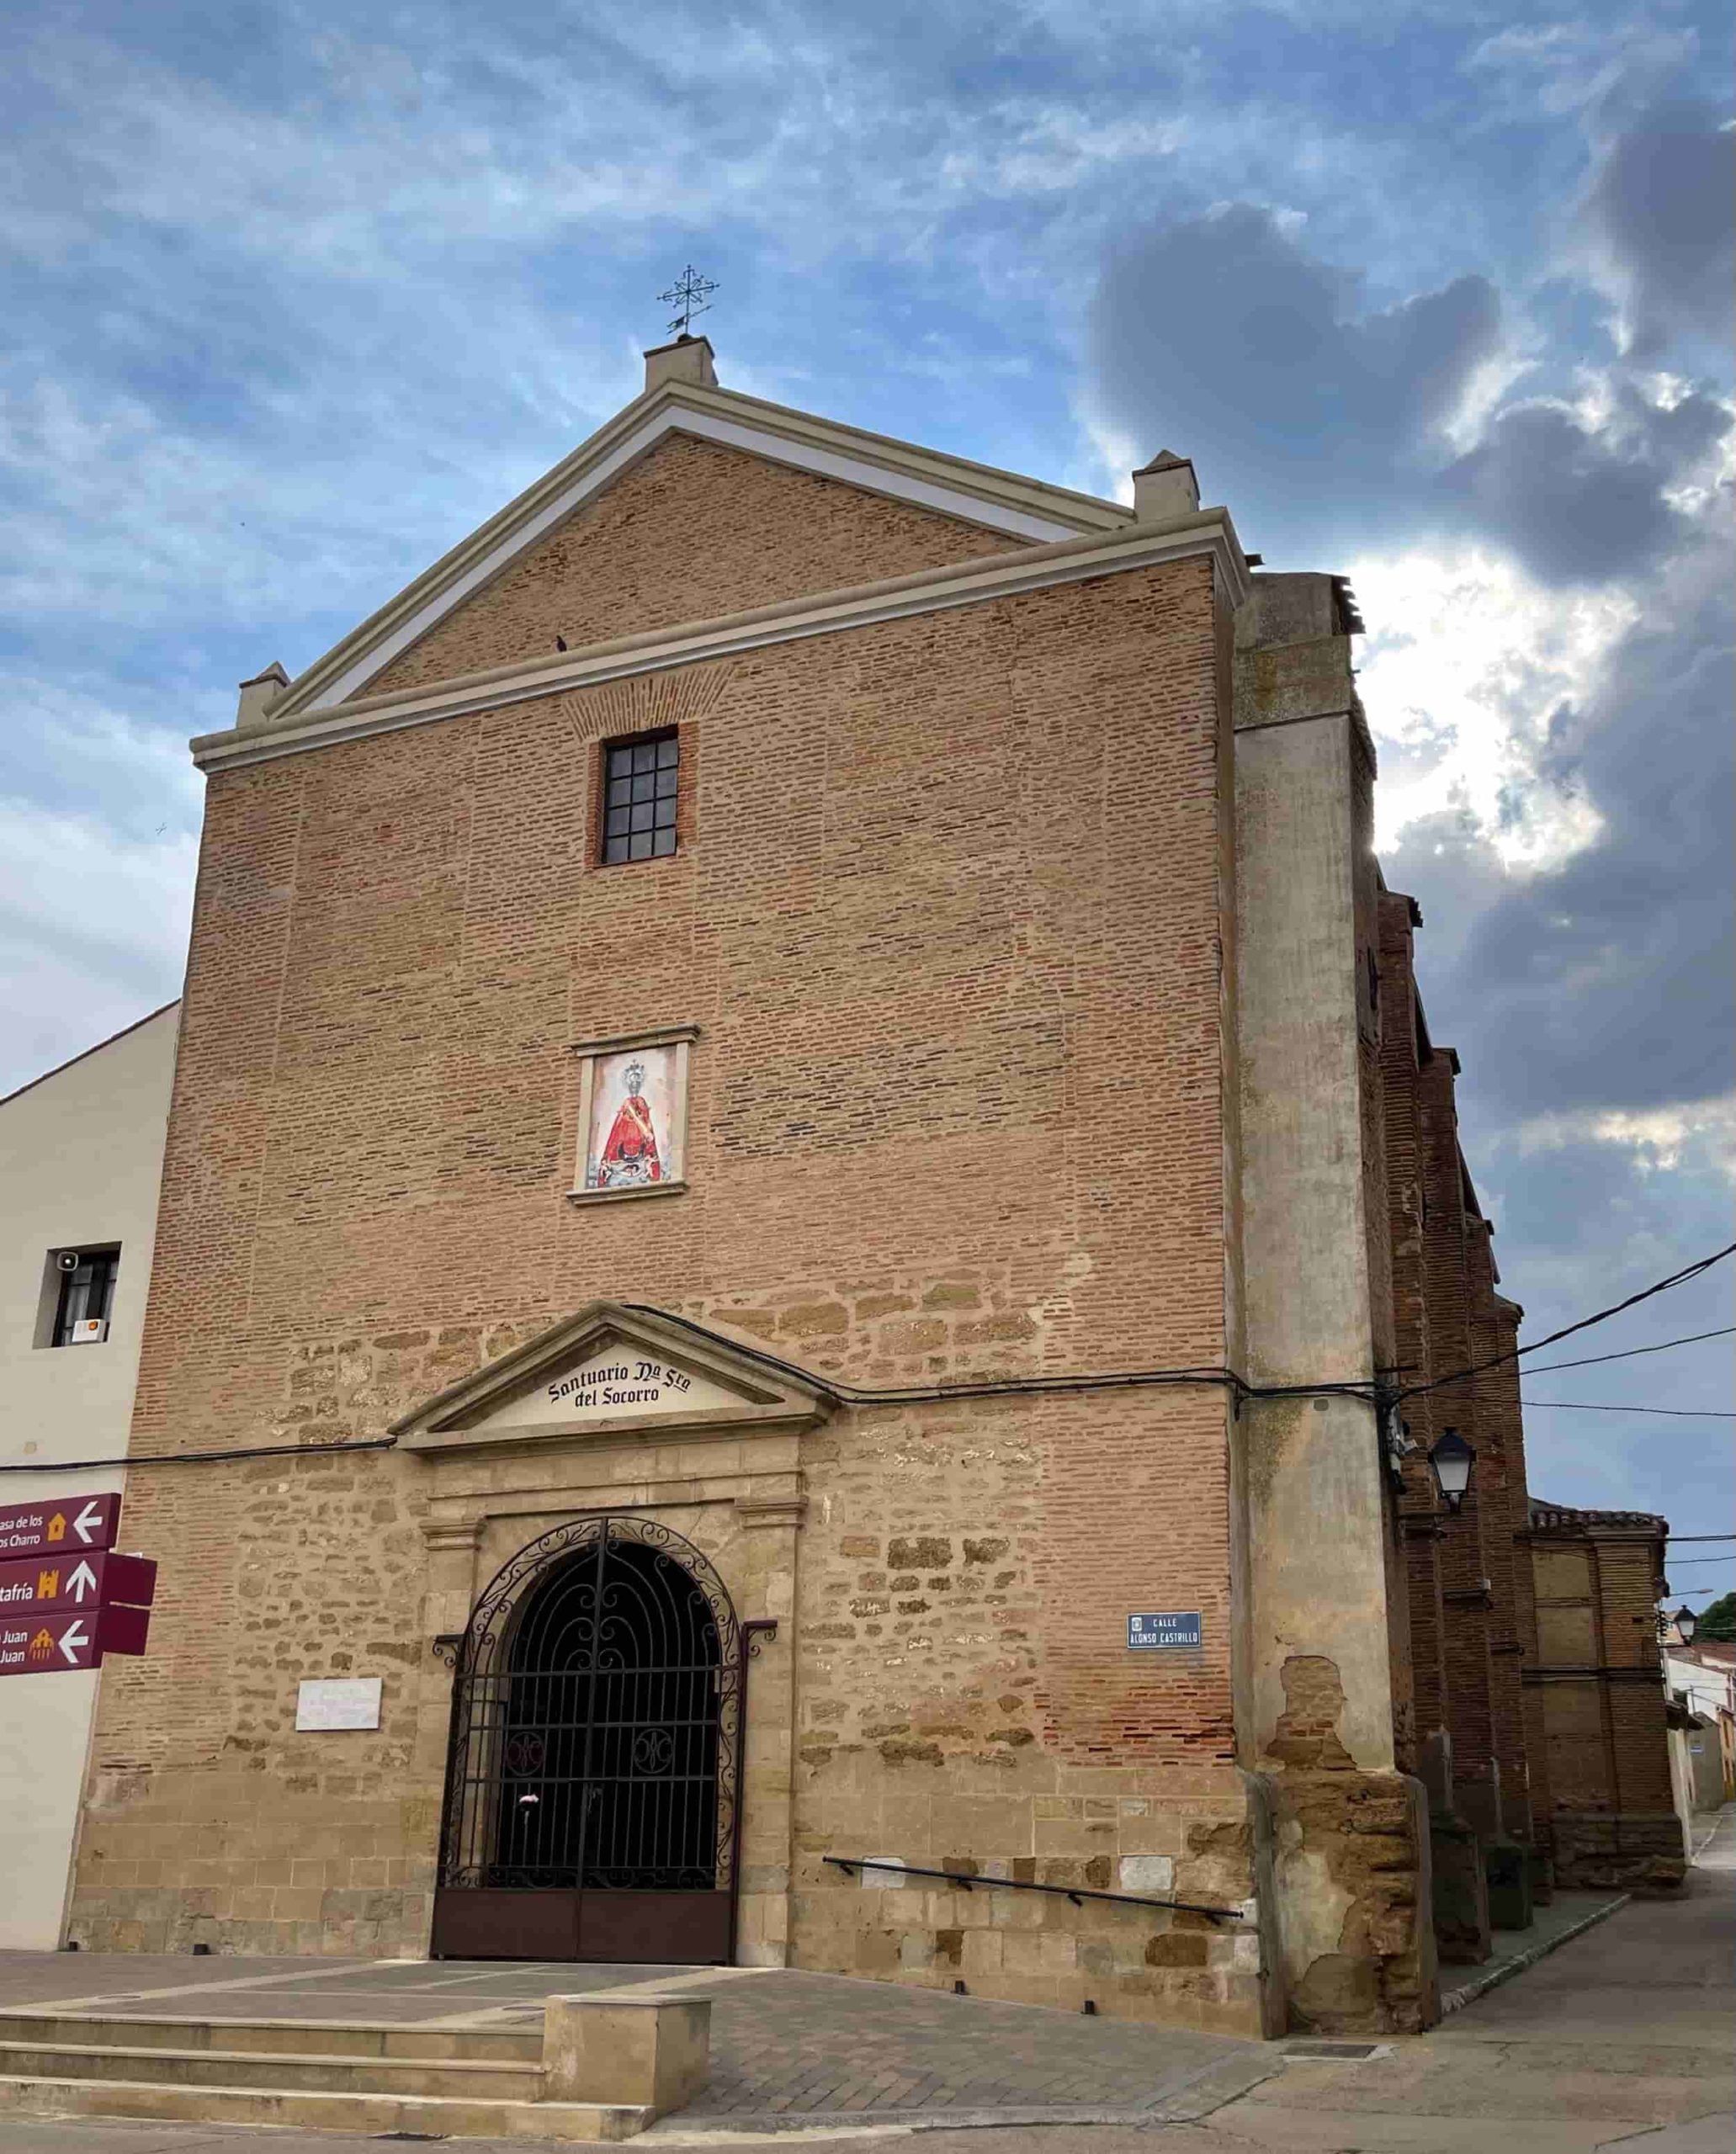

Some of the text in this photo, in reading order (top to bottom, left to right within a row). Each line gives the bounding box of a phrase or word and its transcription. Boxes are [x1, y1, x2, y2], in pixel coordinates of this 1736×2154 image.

[548, 1362, 629, 1403] Santuario
[575, 1387, 659, 1407] del Socorro
[16, 1516, 28, 1528] de
[29, 1515, 43, 1527] los
[10, 1534, 40, 1547] Charro
[1153, 1618, 1177, 1627] CALLE
[3, 1630, 28, 1644] Juan
[1130, 1632, 1197, 1644] ALONSO CASTRILLO
[0, 1649, 25, 1664] Juan
